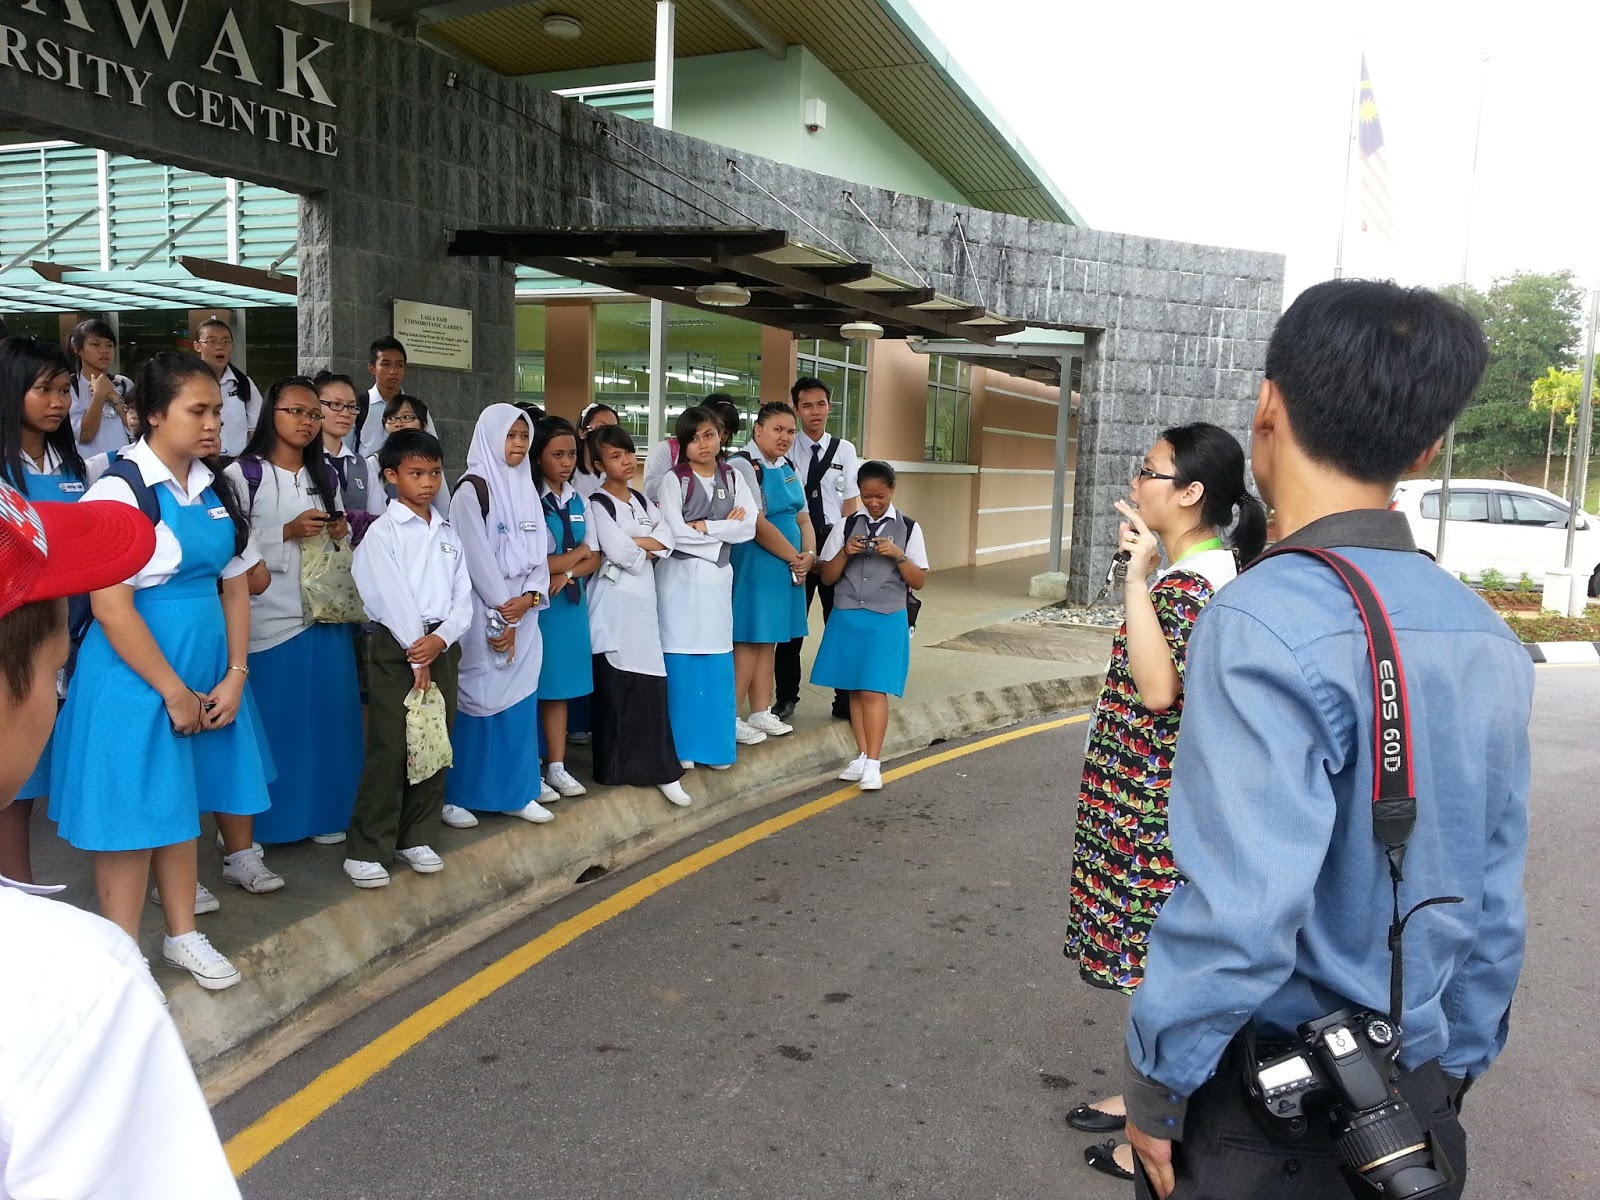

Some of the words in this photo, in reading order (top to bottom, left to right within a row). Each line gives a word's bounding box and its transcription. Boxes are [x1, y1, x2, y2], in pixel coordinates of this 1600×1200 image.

[0, 24, 153, 107] RSITY
[167, 80, 339, 157] CENTRE
[1379, 659, 1399, 721] EOS
[1383, 728, 1401, 773] 60D
